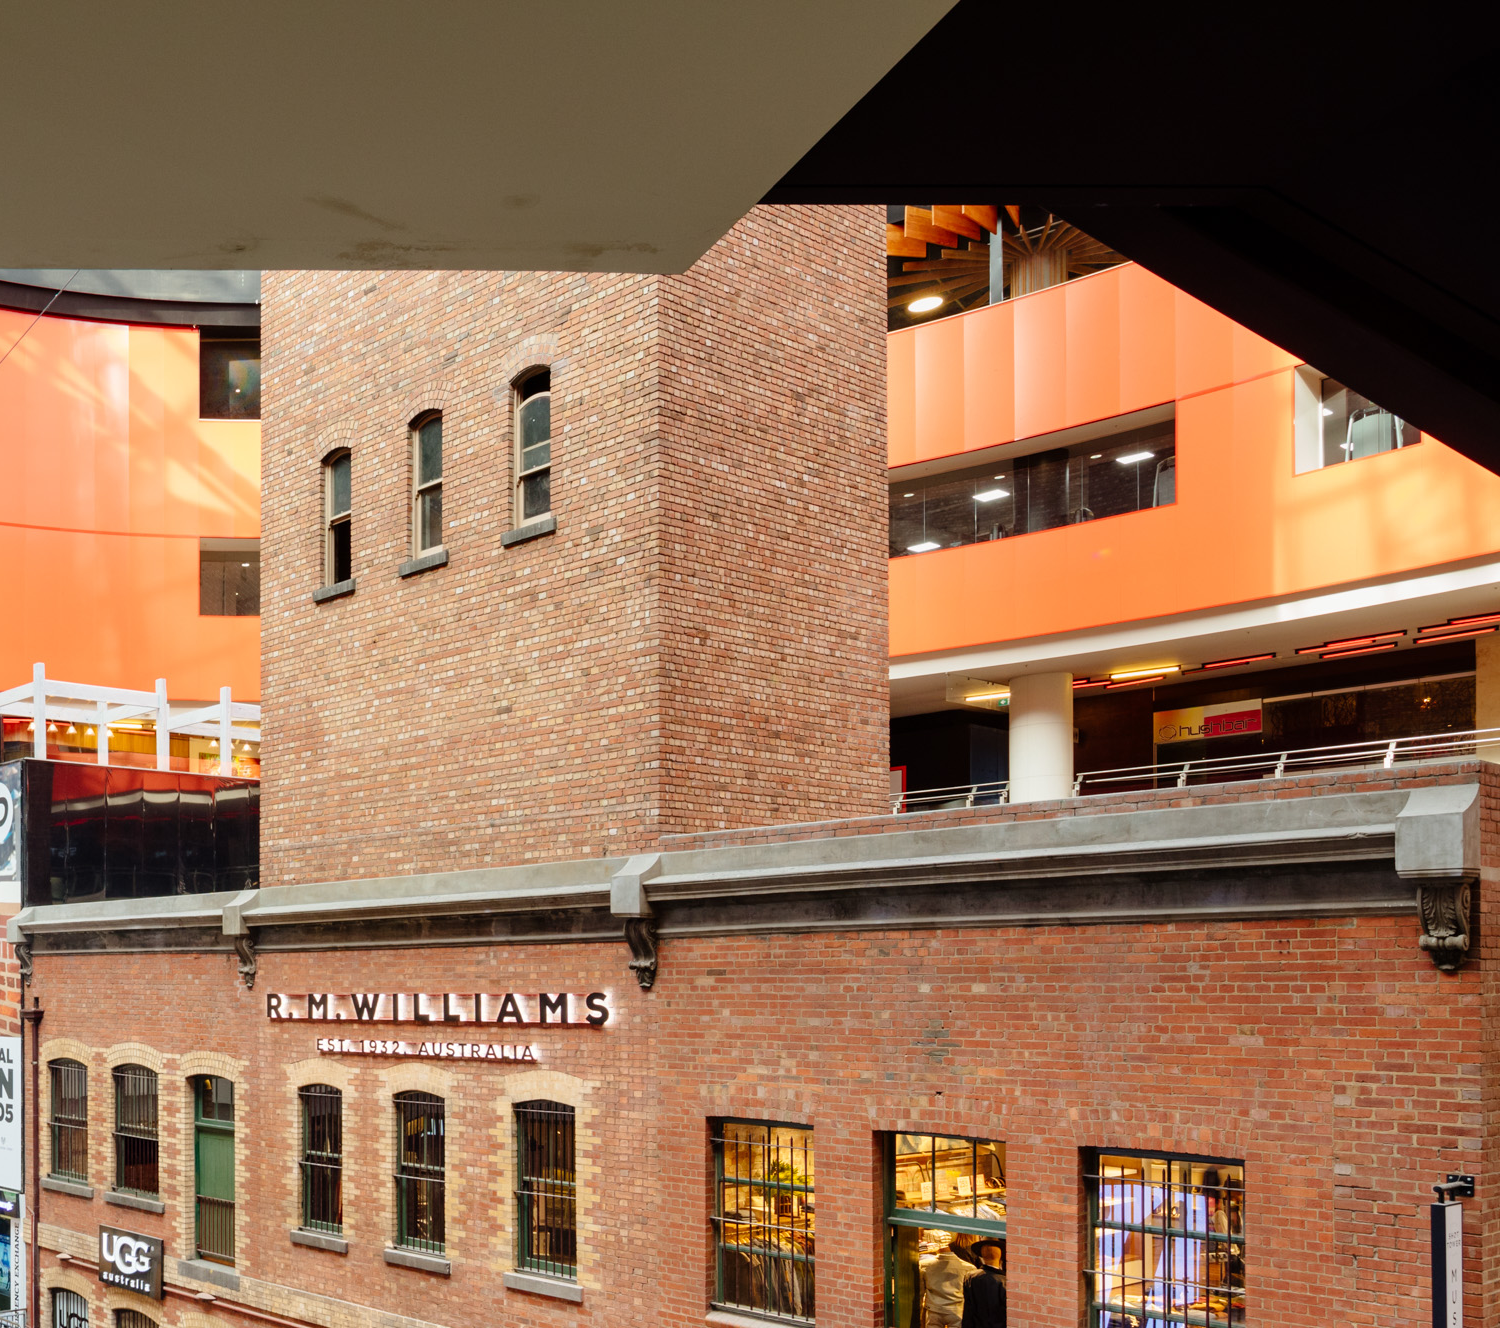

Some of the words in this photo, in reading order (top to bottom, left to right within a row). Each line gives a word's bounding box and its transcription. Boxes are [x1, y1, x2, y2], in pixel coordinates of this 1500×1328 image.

[1179, 718, 1257, 737] hushbar
[418, 1042, 534, 1062] AUSTRALIA
[101, 1231, 152, 1275] UGG
[102, 1269, 150, 1292] australia
